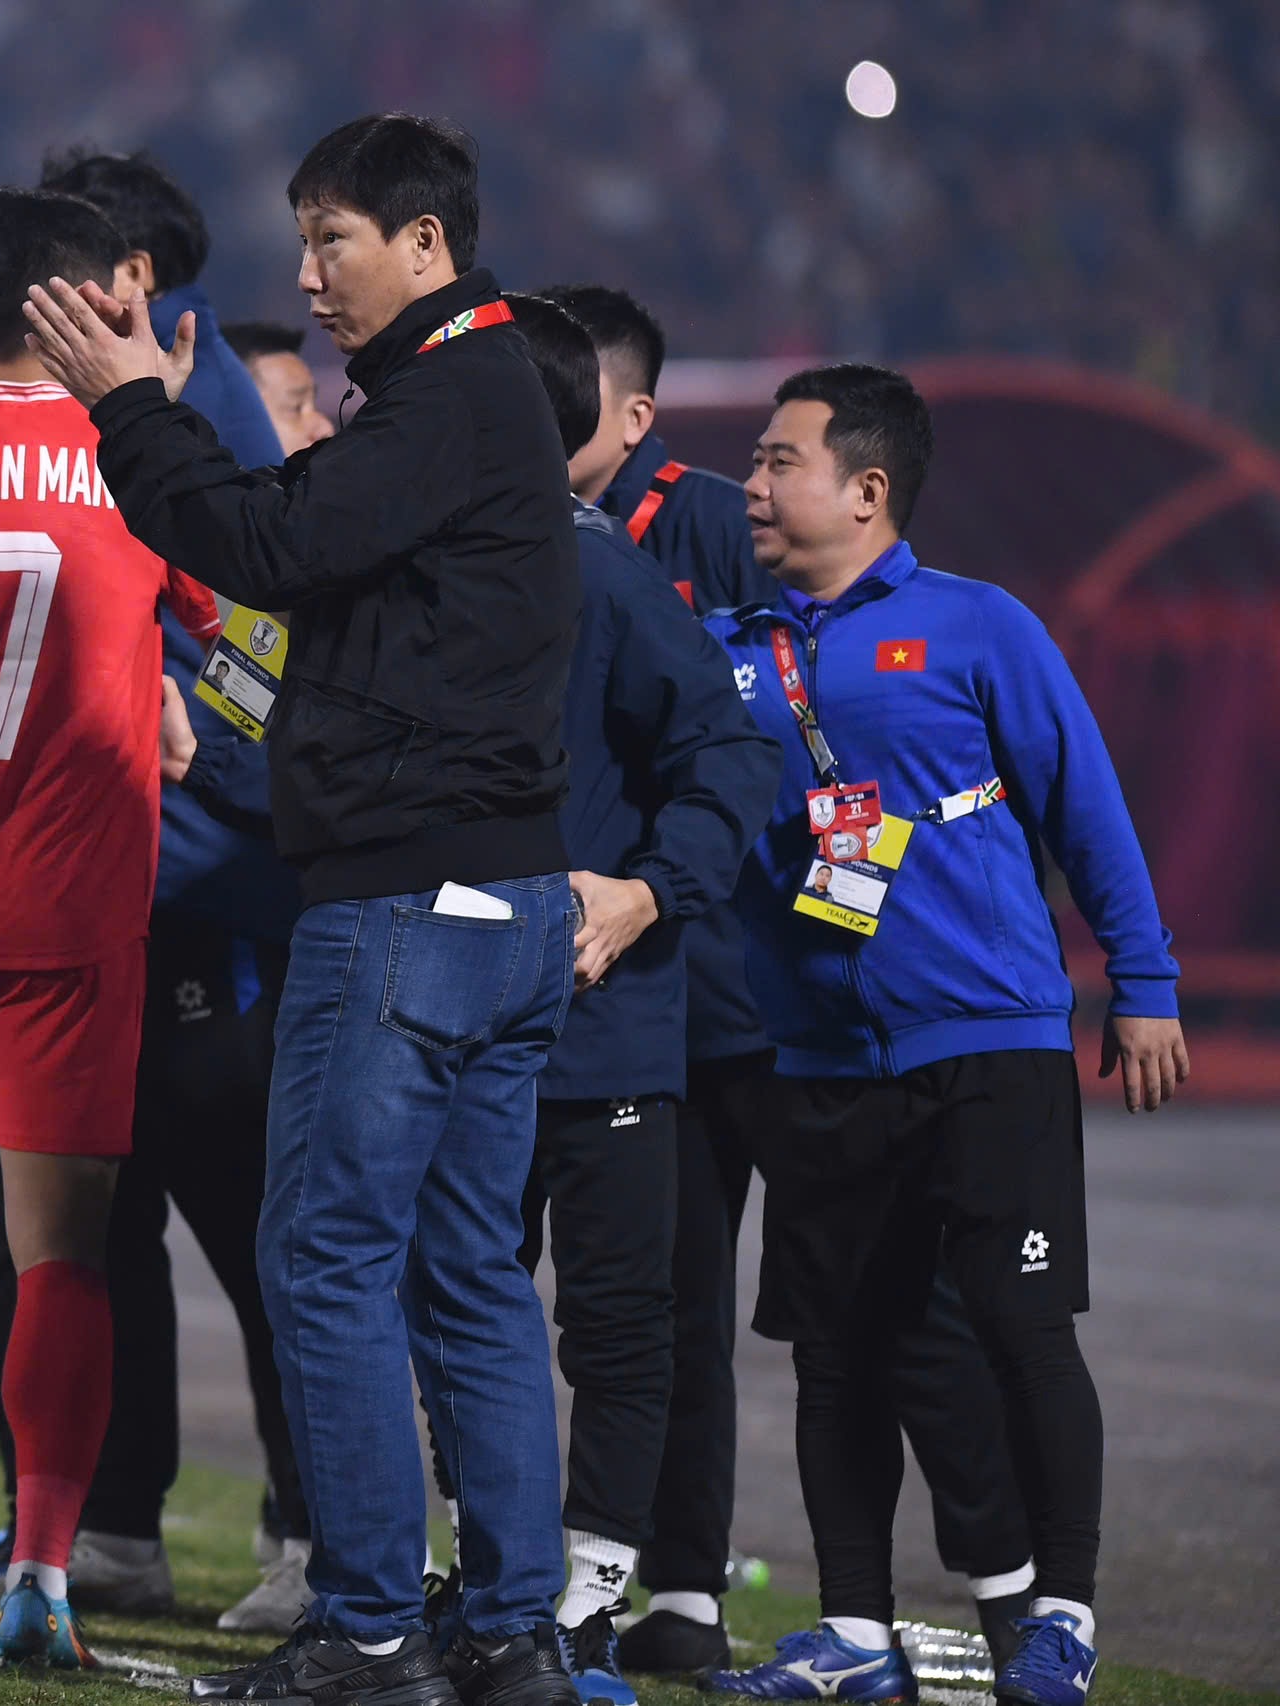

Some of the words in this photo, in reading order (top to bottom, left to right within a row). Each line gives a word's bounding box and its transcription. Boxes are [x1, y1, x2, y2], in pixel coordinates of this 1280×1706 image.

[230, 648, 248, 665] FINAL
[246, 660, 270, 682] ROUNDS
[219, 700, 239, 719] TEAM
[850, 802, 862, 815] 21
[825, 907, 845, 920] TEAM
